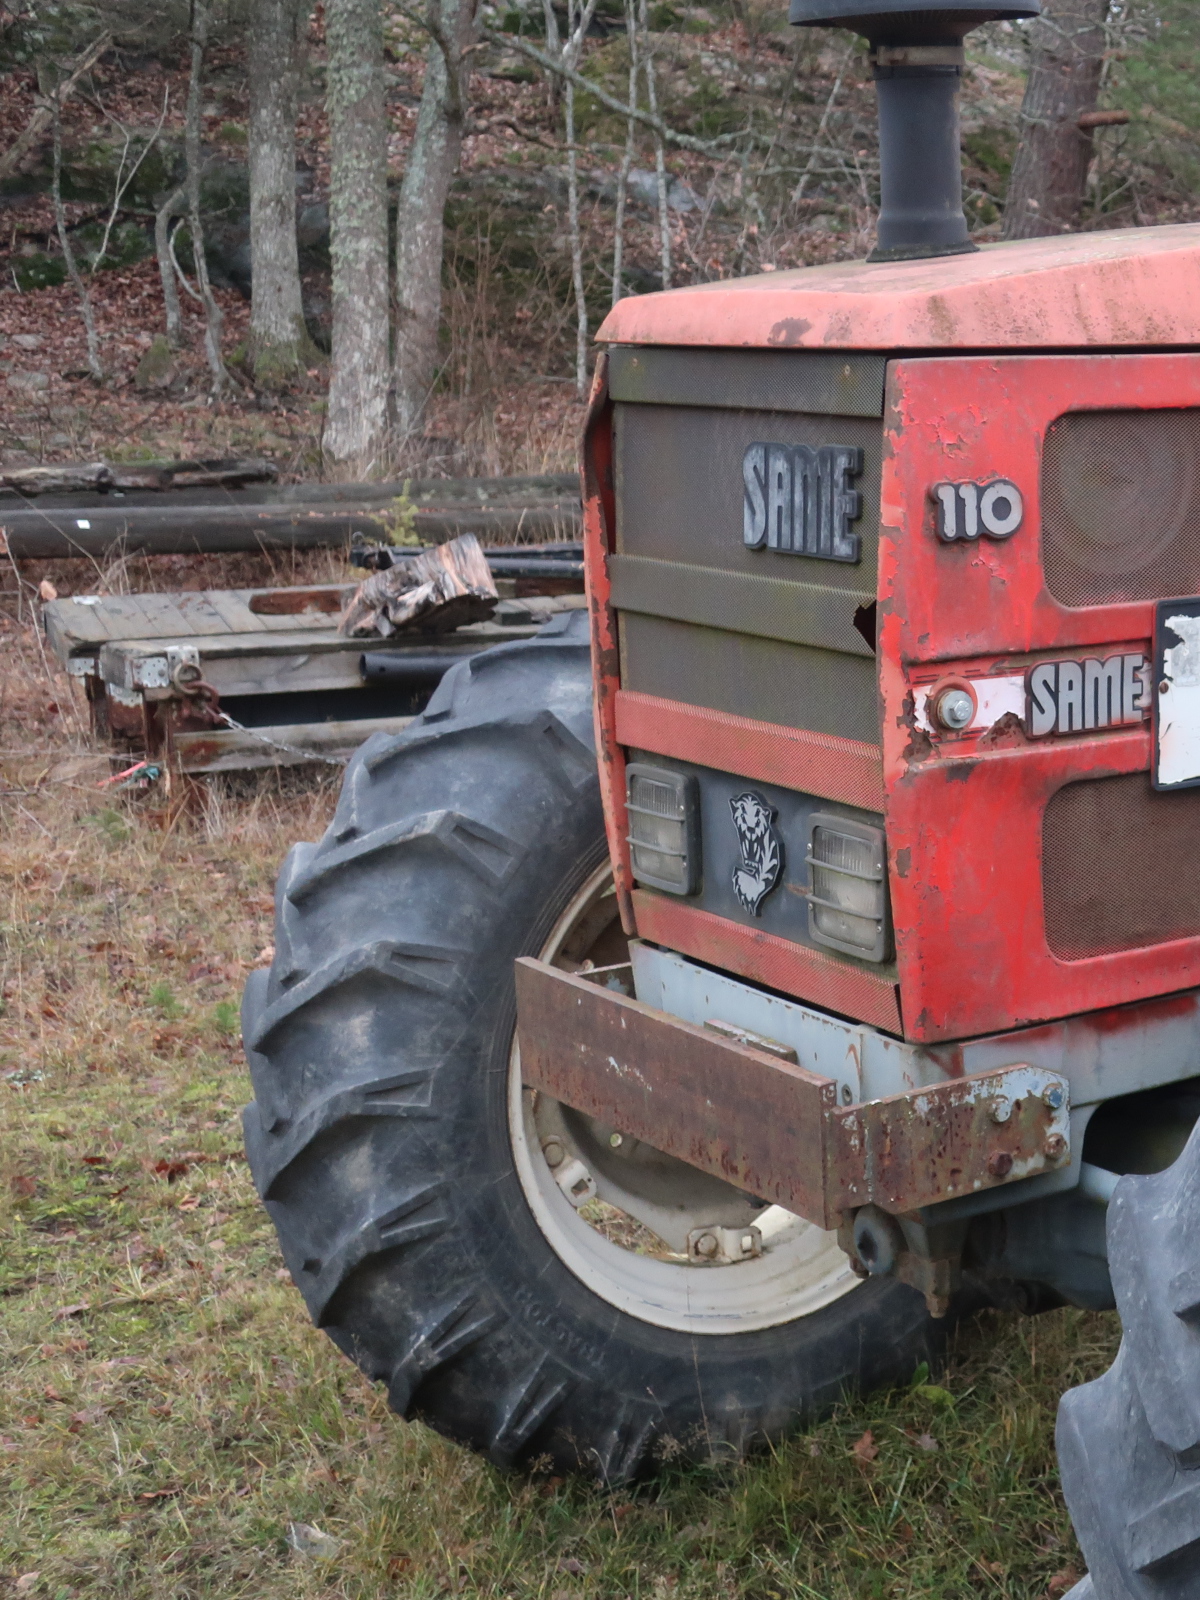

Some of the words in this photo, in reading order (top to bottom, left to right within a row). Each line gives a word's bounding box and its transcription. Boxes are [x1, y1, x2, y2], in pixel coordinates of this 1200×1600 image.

[743, 444, 857, 559] SAME
[937, 484, 1022, 537] 110
[1031, 654, 1142, 736] SAME
